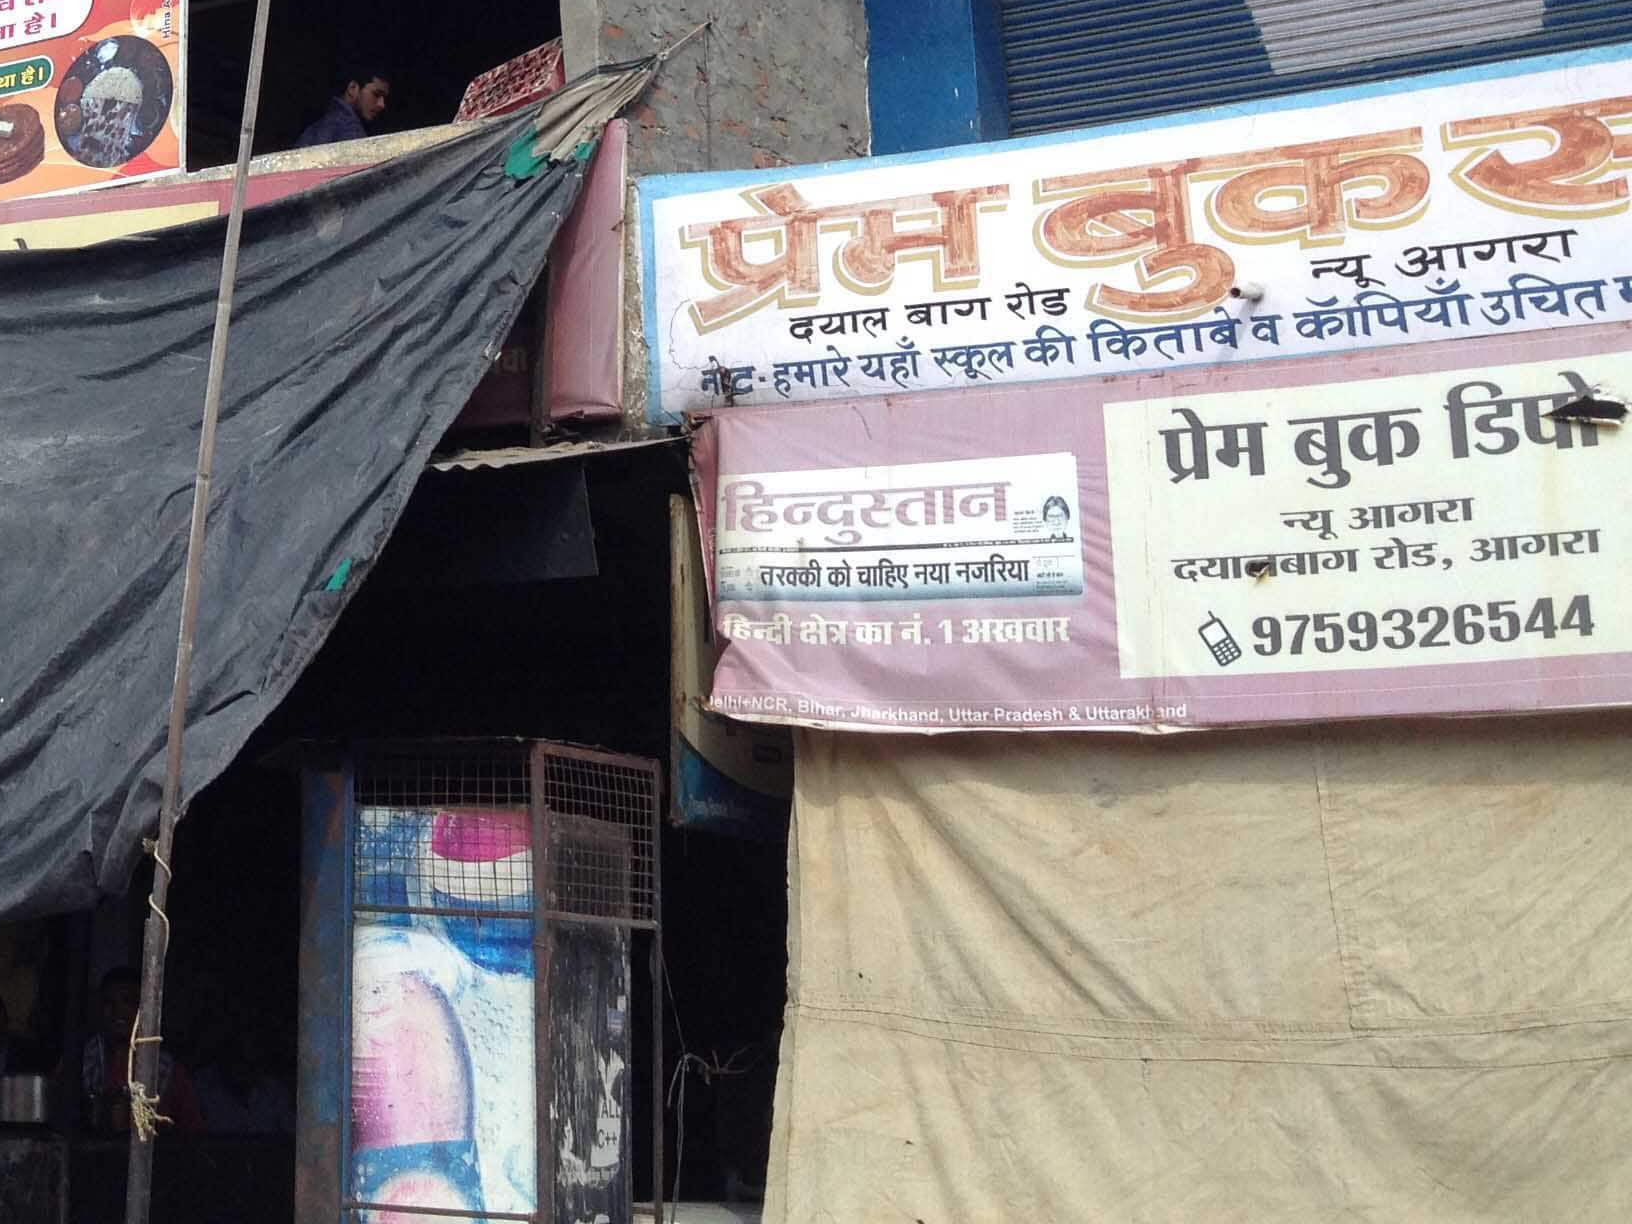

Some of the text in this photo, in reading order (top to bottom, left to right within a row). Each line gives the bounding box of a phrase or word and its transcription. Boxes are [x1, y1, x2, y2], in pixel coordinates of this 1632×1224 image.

[678, 182, 1013, 336] प्रेम
[1034, 126, 1430, 322] बुक
[1310, 229, 1578, 289] न्यू आगरा
[788, 282, 1070, 345] दयाल बाग रोड
[856, 336, 924, 388] यहाँ
[930, 340, 1016, 380] स्कूल
[1022, 324, 1077, 367] की
[1251, 312, 1283, 345] व
[1480, 272, 1609, 327] उचित
[1159, 371, 1602, 489] प्रेम बुक डिपो
[719, 480, 1012, 546] हिन्दुस्तान
[1280, 497, 1475, 540] न्यू आगरा
[759, 559, 822, 588] तरक्की
[826, 559, 852, 588] को
[855, 558, 909, 588] चाहिए
[913, 561, 951, 585] नया
[955, 554, 1030, 582] नजरिया
[1470, 528, 1601, 563] आगरा
[722, 613, 793, 646] हिन्दी
[799, 614, 849, 646] क्षेत्र
[853, 621, 894, 646] का
[938, 618, 953, 644] 1
[1251, 594, 1596, 657] 9759326544
[710, 695, 793, 713] elhi+NCR,
[949, 708, 990, 721] Uttar
[994, 707, 1064, 722] Pradesh
[1069, 709, 1082, 721] &
